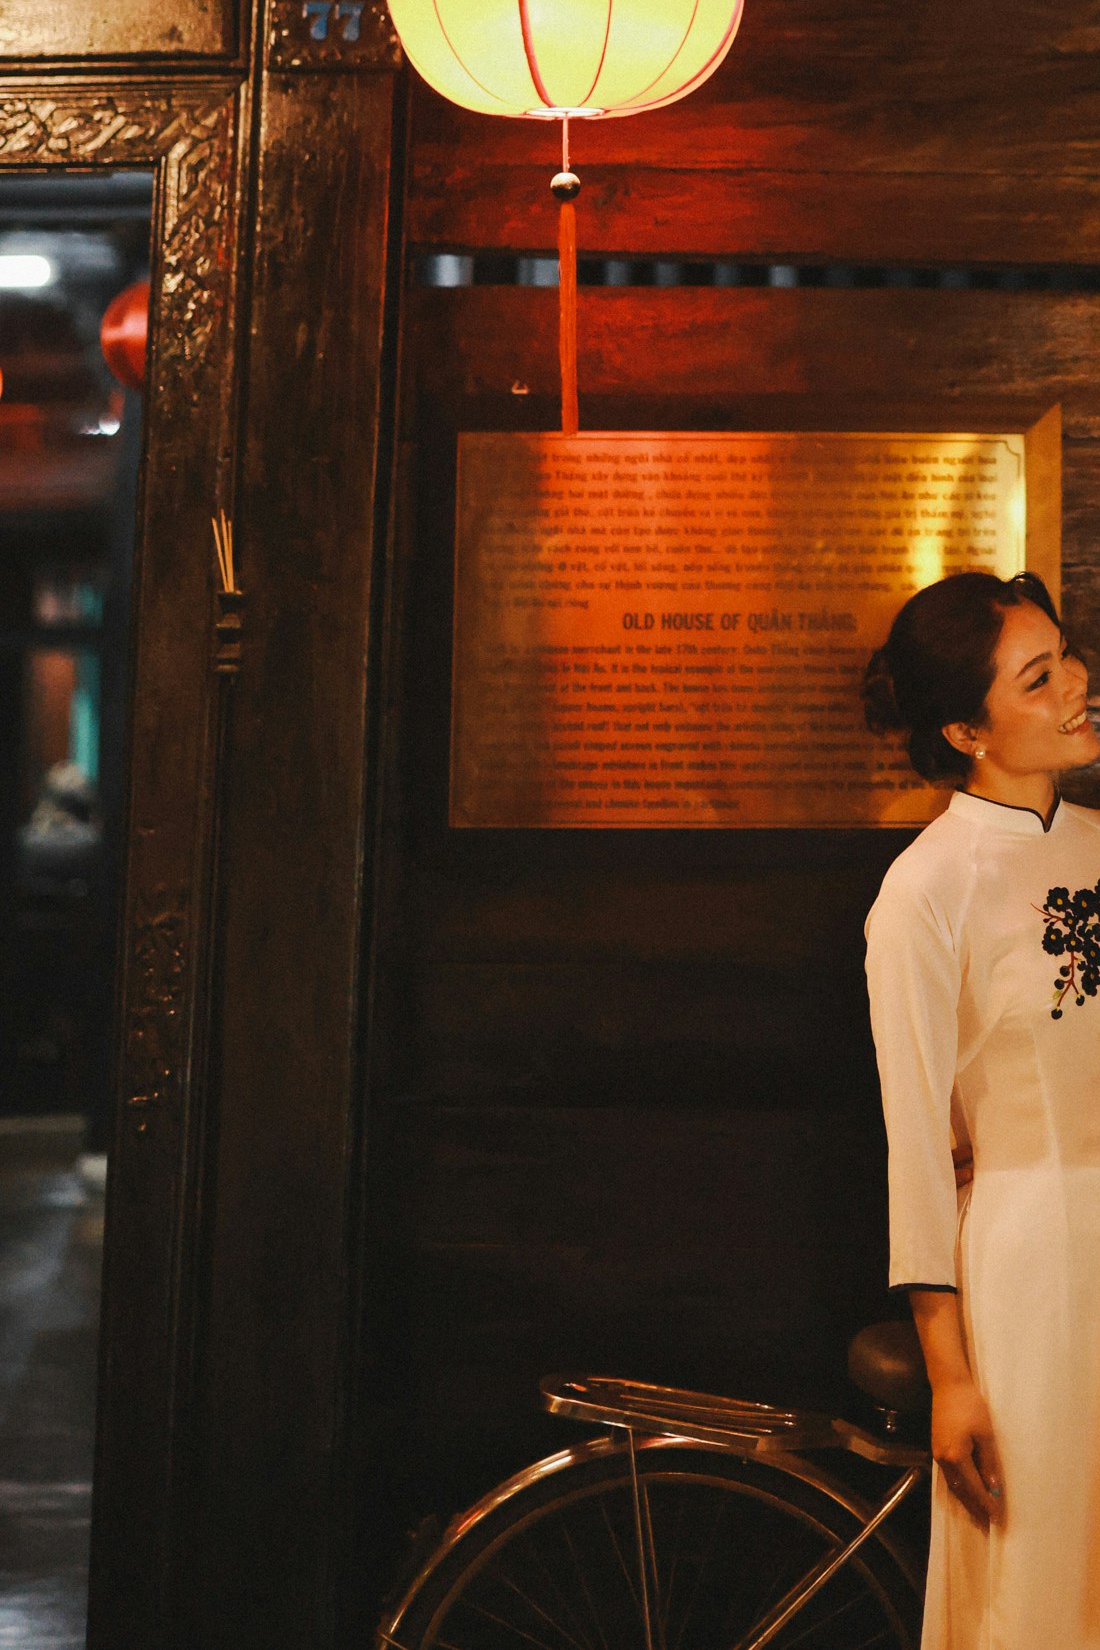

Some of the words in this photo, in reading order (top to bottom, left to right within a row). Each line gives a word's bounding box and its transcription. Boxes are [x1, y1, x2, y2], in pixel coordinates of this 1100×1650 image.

[303, 1, 365, 41] 77
[622, 612, 655, 631] OLD
[661, 612, 715, 631] HOUSE
[720, 612, 742, 631] OF
